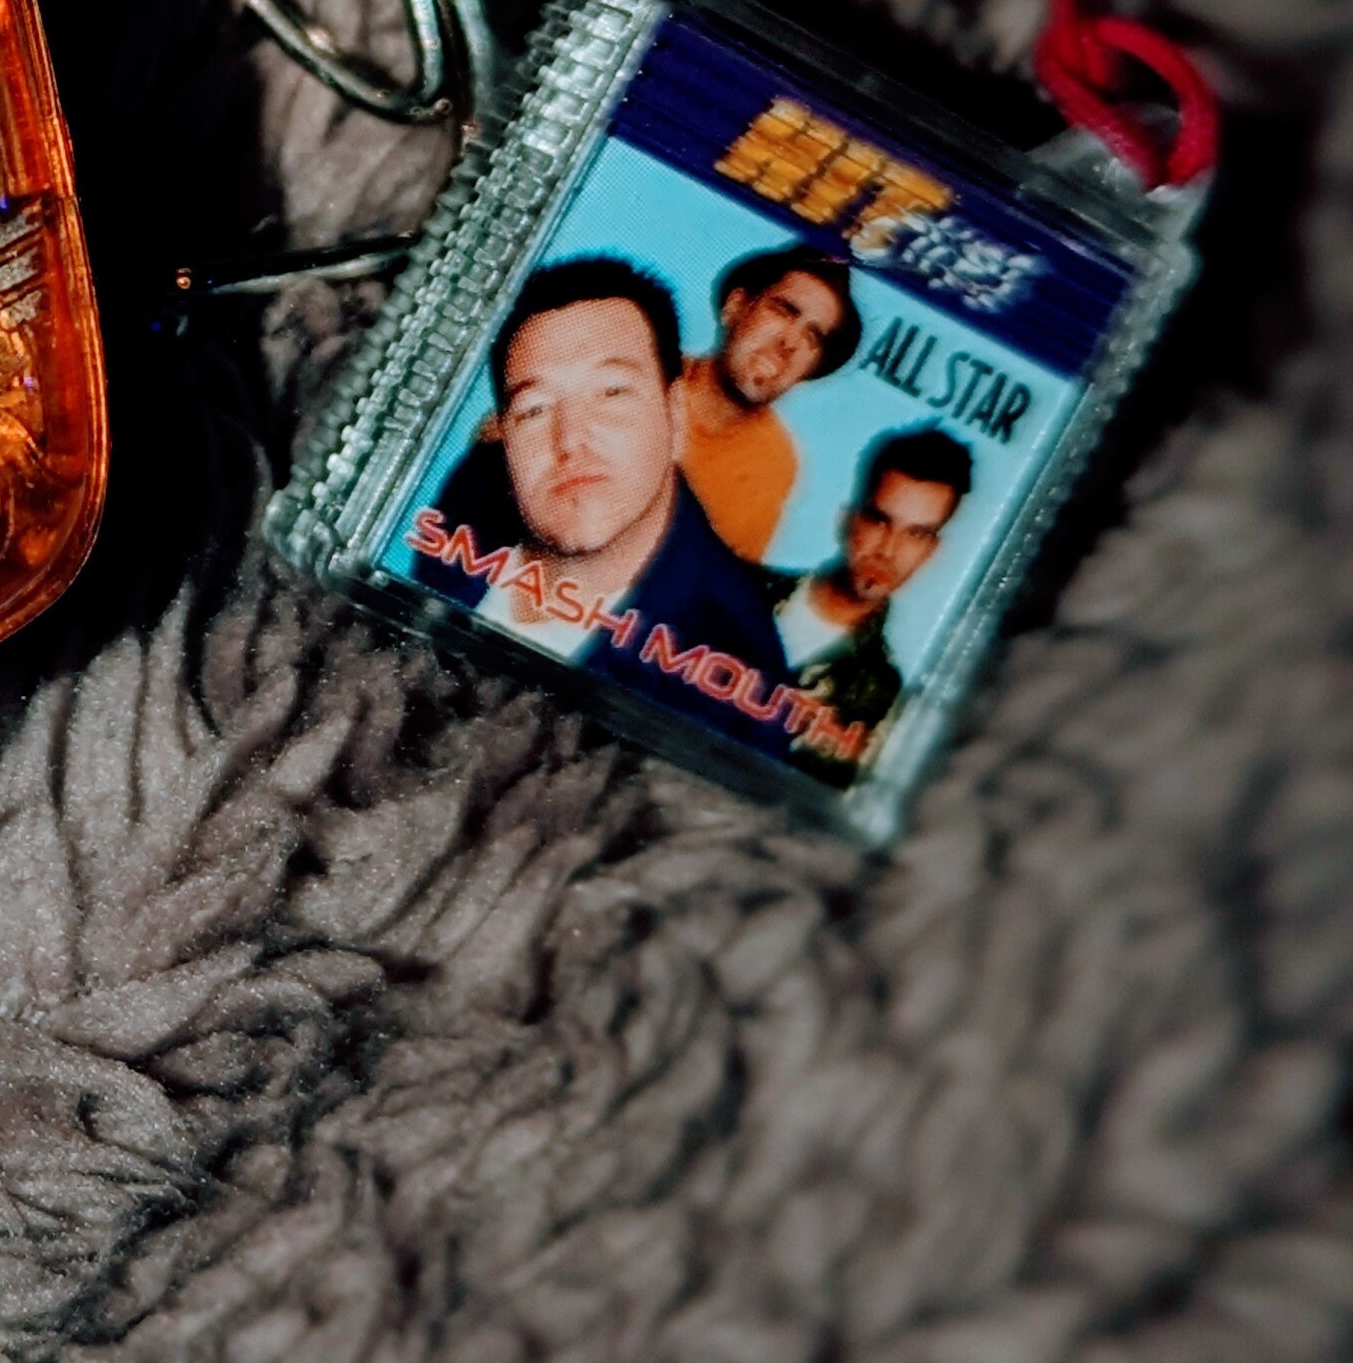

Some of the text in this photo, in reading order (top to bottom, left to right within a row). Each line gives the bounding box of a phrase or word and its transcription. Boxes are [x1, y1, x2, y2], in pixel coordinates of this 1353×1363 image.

[713, 96, 952, 239] HIT
[858, 316, 1032, 445] ALL STAR
[408, 506, 868, 759] SMASH MOUTH
